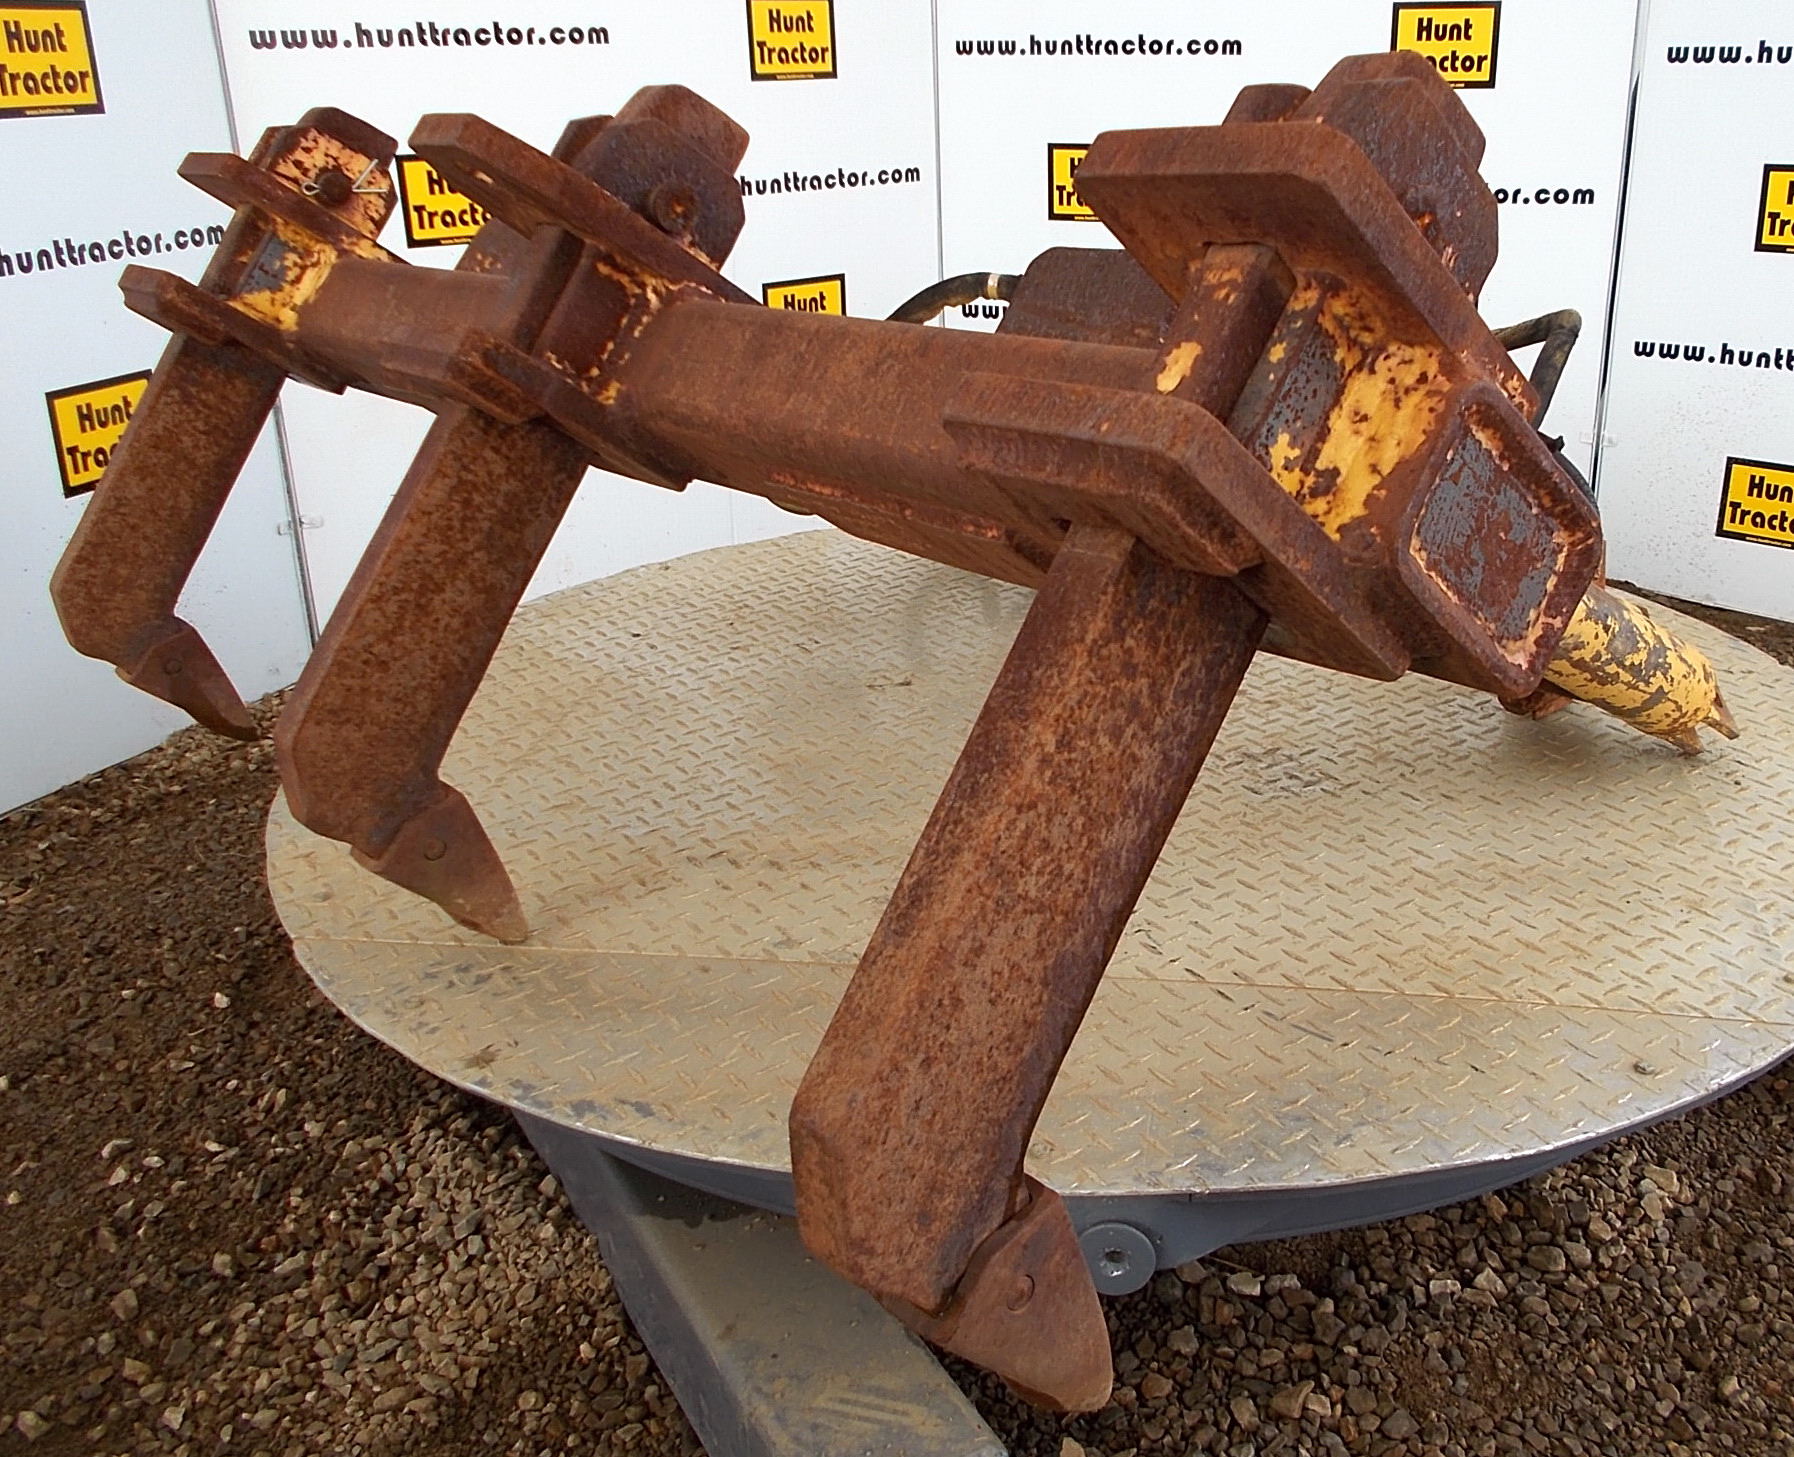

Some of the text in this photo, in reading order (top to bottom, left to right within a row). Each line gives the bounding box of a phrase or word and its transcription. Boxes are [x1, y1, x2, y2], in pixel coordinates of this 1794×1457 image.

[767, 9, 814, 32] Hunt
[1416, 17, 1473, 41] Hunt
[3, 20, 68, 53] Hunt
[249, 21, 610, 50] www.hunttractor.com
[955, 34, 1242, 56] www.hunttractor.com
[756, 41, 829, 64] Tractor
[740, 167, 920, 196] hunttractor.com
[413, 202, 493, 230] Tracto
[783, 291, 827, 312] Hunt
[962, 304, 1007, 319] ww
[76, 395, 134, 434] Hunt
